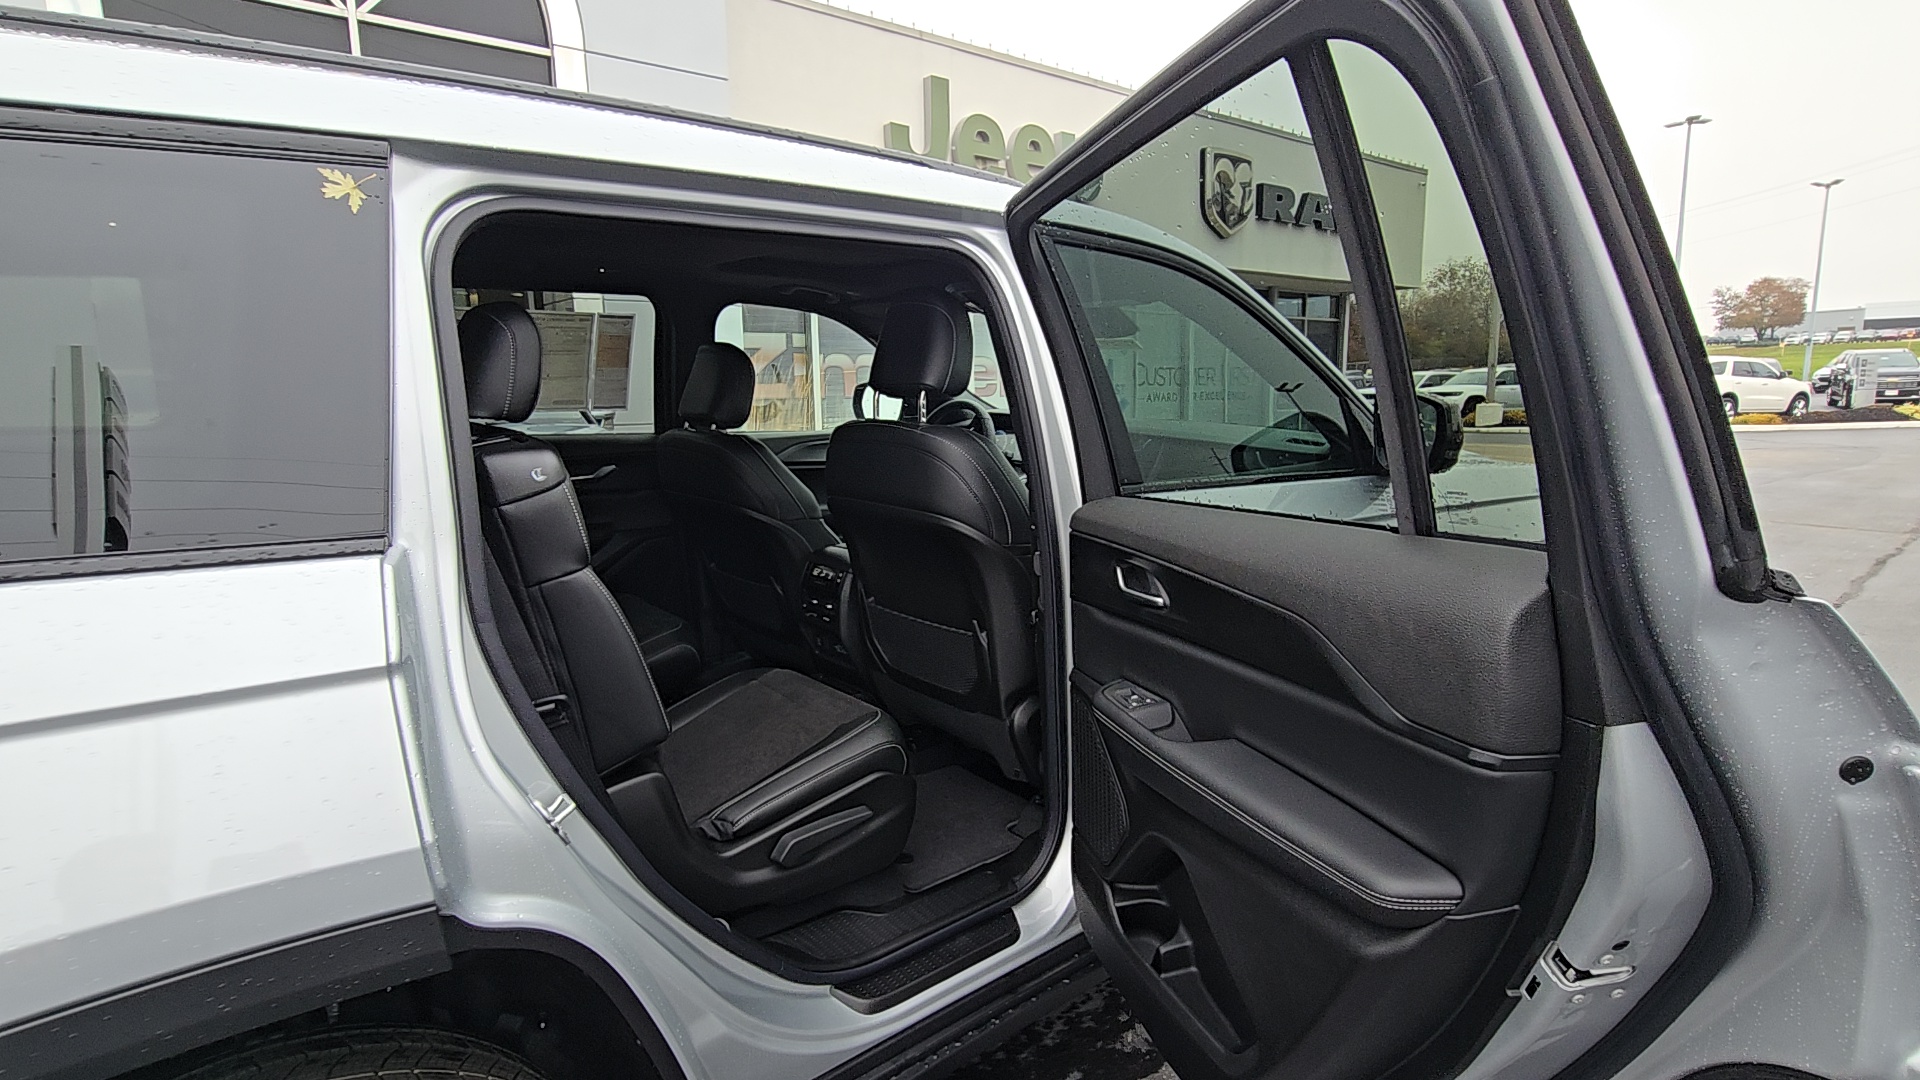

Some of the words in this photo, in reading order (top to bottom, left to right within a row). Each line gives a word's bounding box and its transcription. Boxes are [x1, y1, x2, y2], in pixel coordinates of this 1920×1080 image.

[1256, 183, 1337, 232] RA
[744, 332, 1004, 398] Zime
[1137, 361, 1216, 387] CUSTOER
[1145, 388, 1178, 403] AWARD
